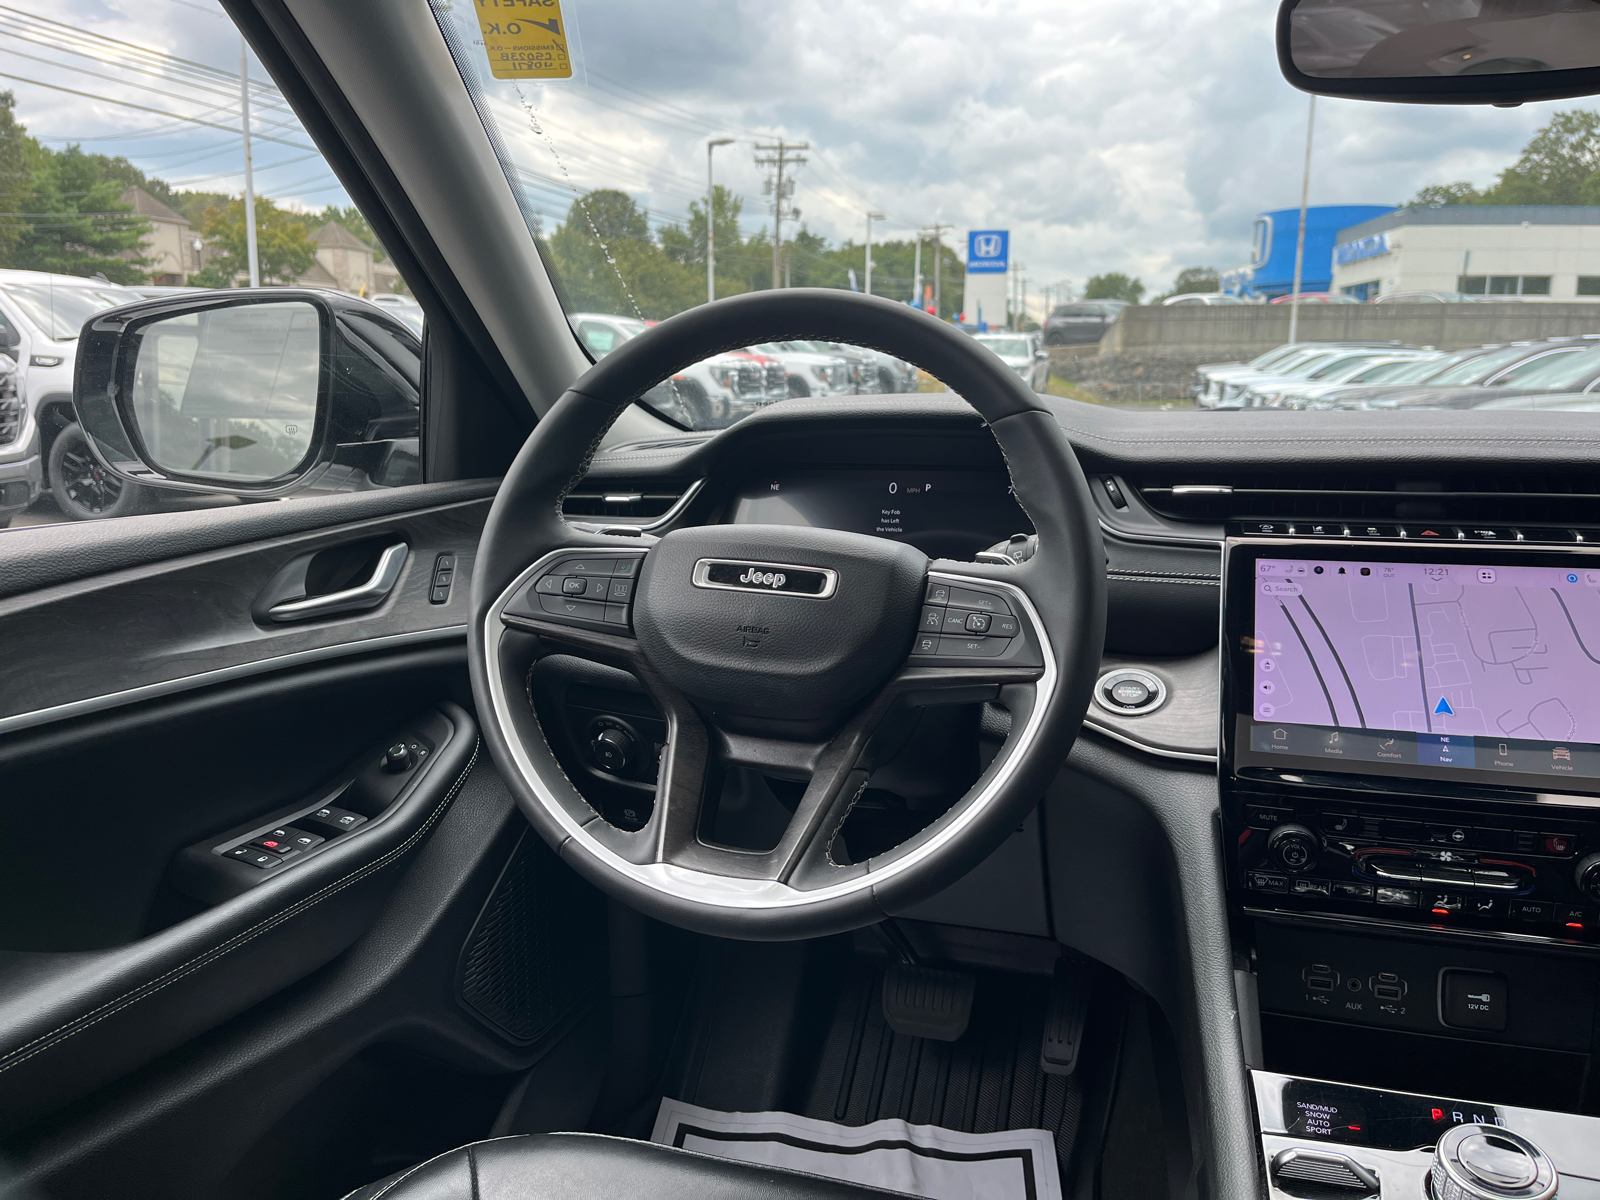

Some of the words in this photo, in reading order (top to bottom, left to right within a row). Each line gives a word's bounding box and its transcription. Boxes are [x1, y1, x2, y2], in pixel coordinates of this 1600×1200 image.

[770, 483, 780, 491] NE
[888, 482, 898, 494] 0
[925, 483, 932, 492] P
[1423, 567, 1449, 576] 12:21
[739, 567, 786, 588] Jeep
[568, 581, 580, 590] OK
[1275, 585, 1299, 593] Search
[947, 617, 963, 625] CANC
[736, 625, 770, 635] AIRBAG
[1324, 747, 1343, 755] Media
[1376, 751, 1402, 759] Comfort
[1440, 755, 1453, 763] Nav
[1268, 879, 1284, 887] MAX
[1345, 1001, 1363, 1011] AUX
[1296, 1101, 1338, 1114] SAND/MUD
[1305, 1110, 1331, 1120] SNOW
[1431, 1108, 1443, 1121] P
[1453, 1111, 1464, 1123] R
[1473, 1114, 1485, 1124] N
[1307, 1118, 1331, 1128] AUTO
[1305, 1125, 1332, 1136] SPORT
